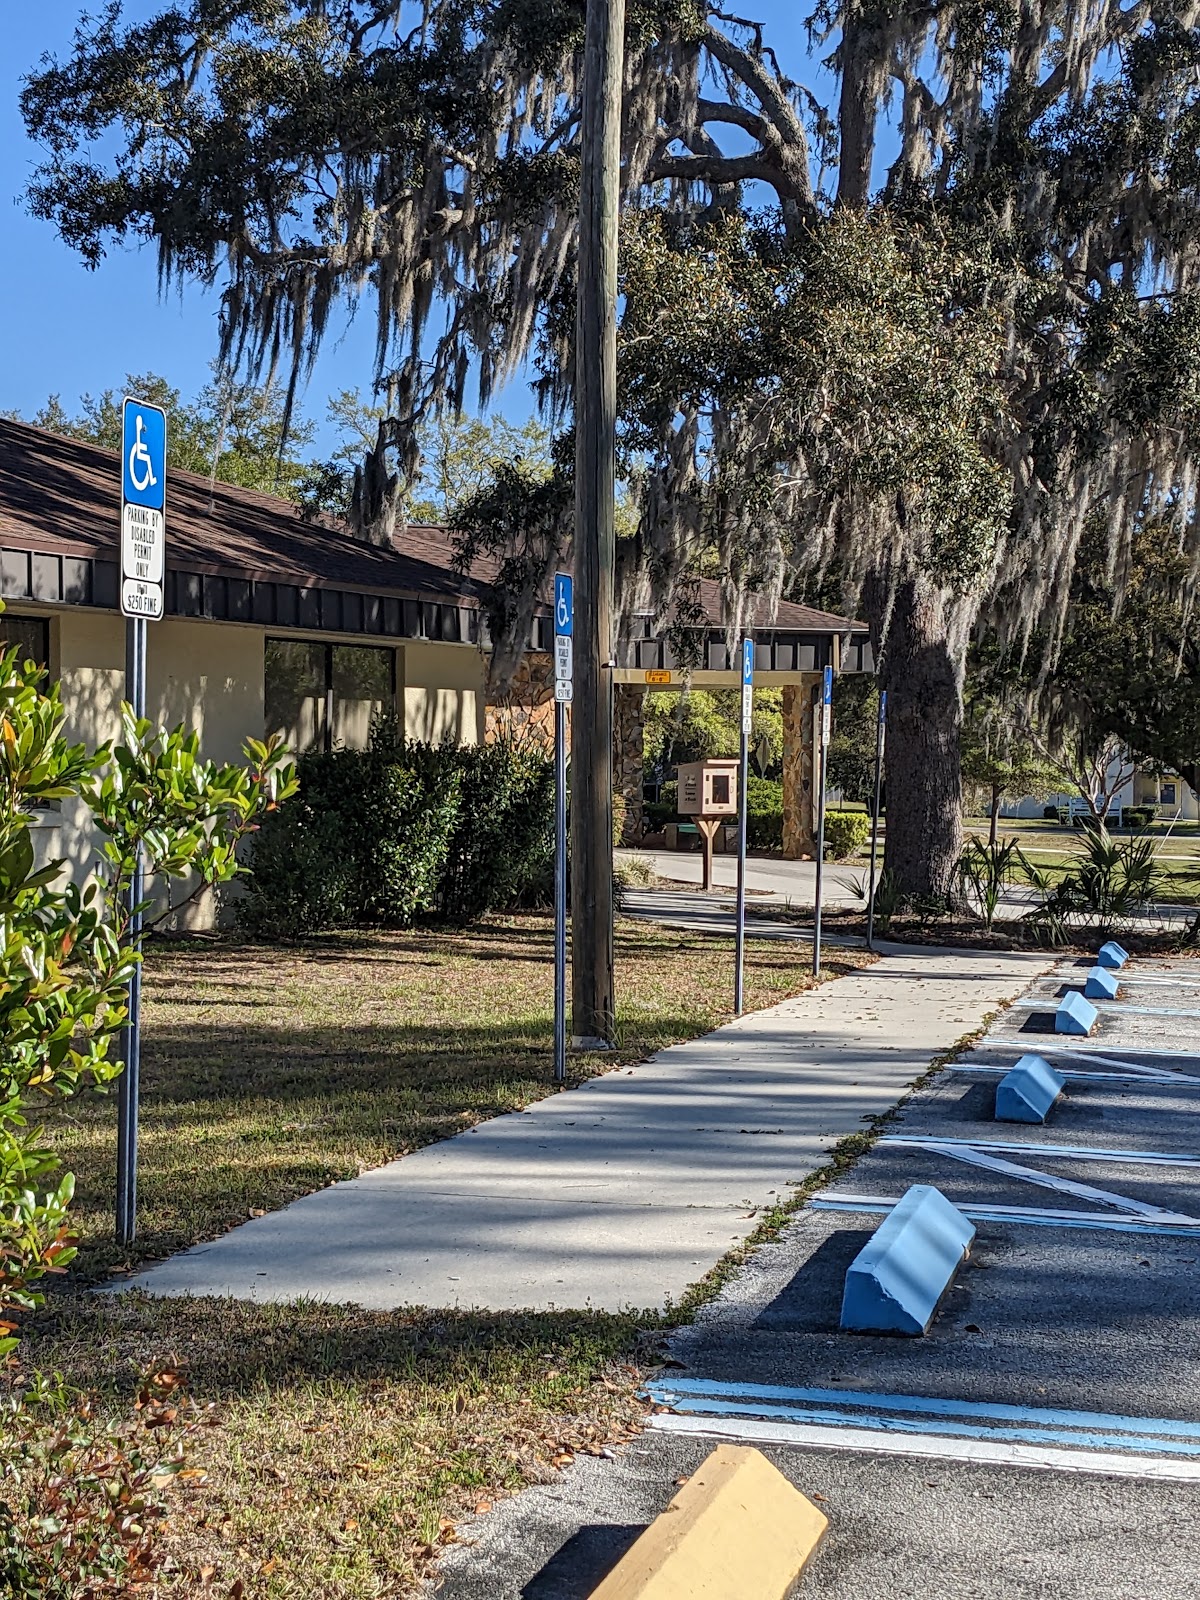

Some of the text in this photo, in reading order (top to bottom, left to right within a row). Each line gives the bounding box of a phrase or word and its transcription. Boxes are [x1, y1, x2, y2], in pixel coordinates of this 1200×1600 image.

[127, 506, 159, 527] PARKING BY
[131, 525, 155, 544] DISABLED
[134, 543, 151, 560] PERMIT
[136, 561, 149, 578] ONLY
[127, 594, 157, 613] $250 FINE
